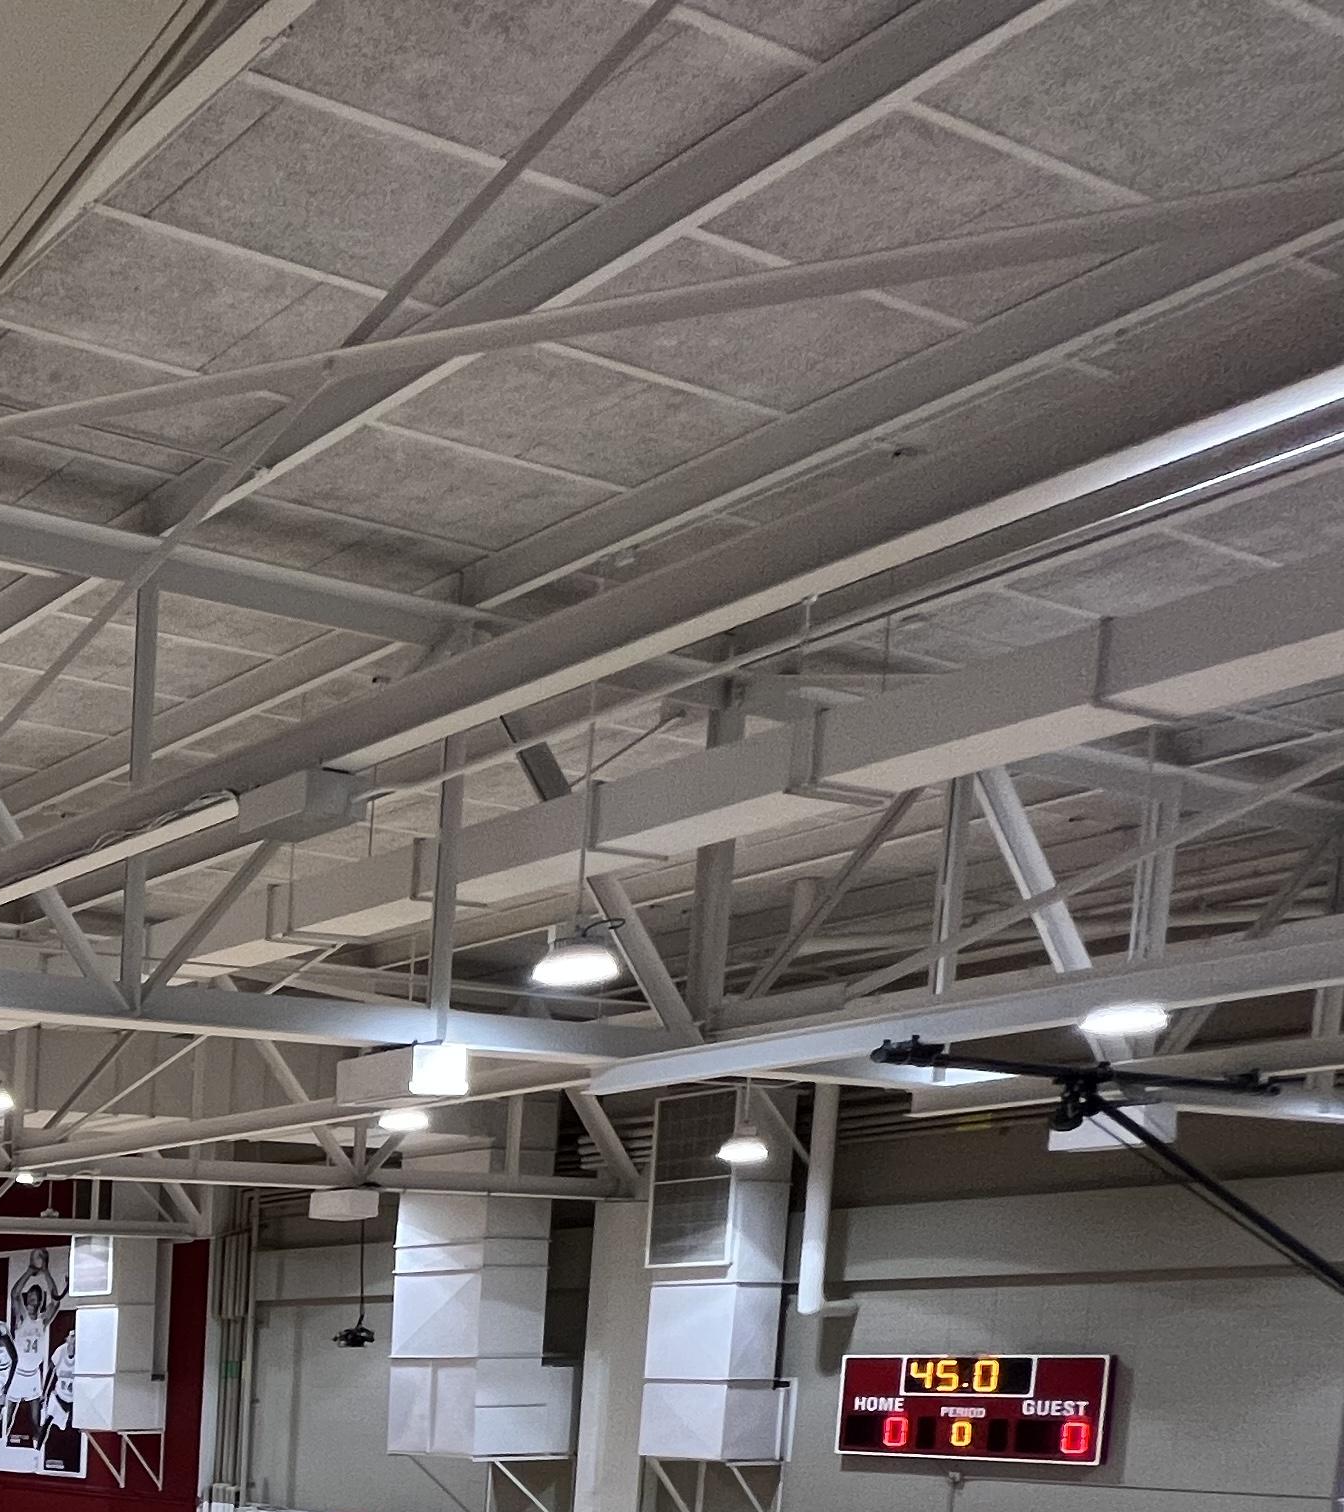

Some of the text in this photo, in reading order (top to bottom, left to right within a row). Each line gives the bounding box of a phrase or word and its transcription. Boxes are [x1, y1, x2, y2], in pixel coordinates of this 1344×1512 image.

[910, 1359, 1000, 1393] 45.0
[854, 1397, 1090, 1416] HOME GUEST
[940, 1407, 986, 1418] PERIOD
[882, 1416, 909, 1447] 0
[950, 1421, 972, 1447] 0
[1061, 1422, 1090, 1454] 0
